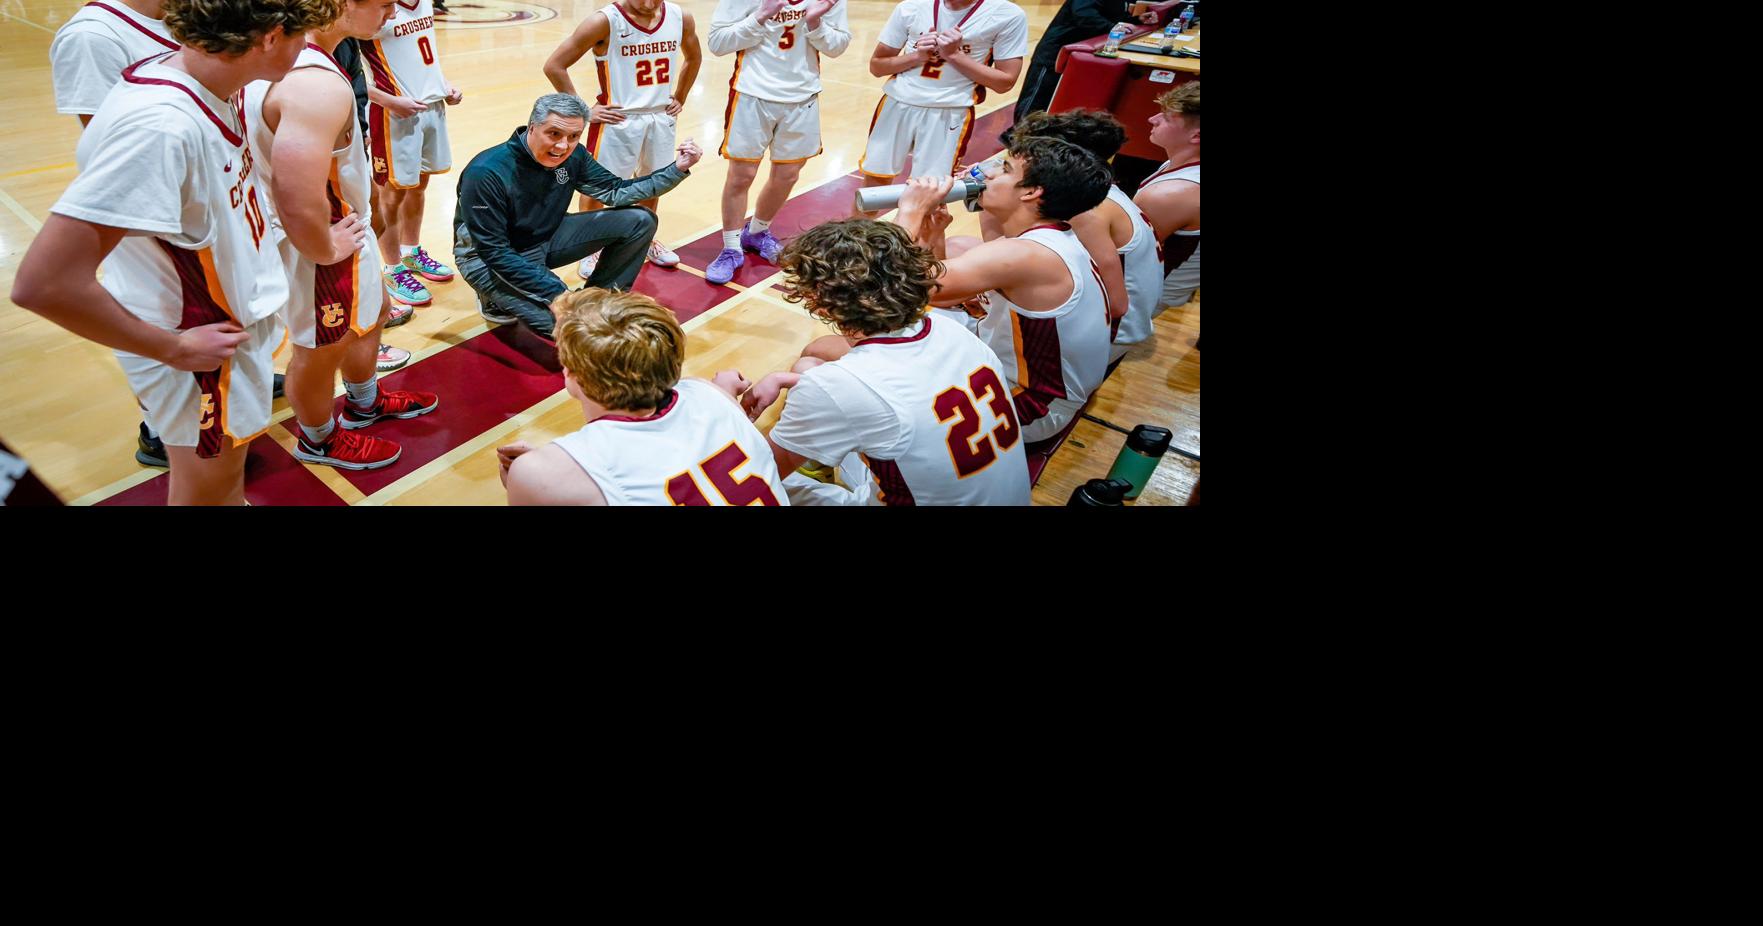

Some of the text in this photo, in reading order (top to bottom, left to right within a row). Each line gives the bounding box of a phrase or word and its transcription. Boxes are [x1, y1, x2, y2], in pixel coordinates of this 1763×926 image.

[417, 35, 434, 66] 0
[621, 40, 677, 57] CRUSHERS
[778, 24, 796, 51] 5
[635, 57, 670, 87] 22
[244, 183, 266, 254] 10
[931, 364, 1021, 480] 23
